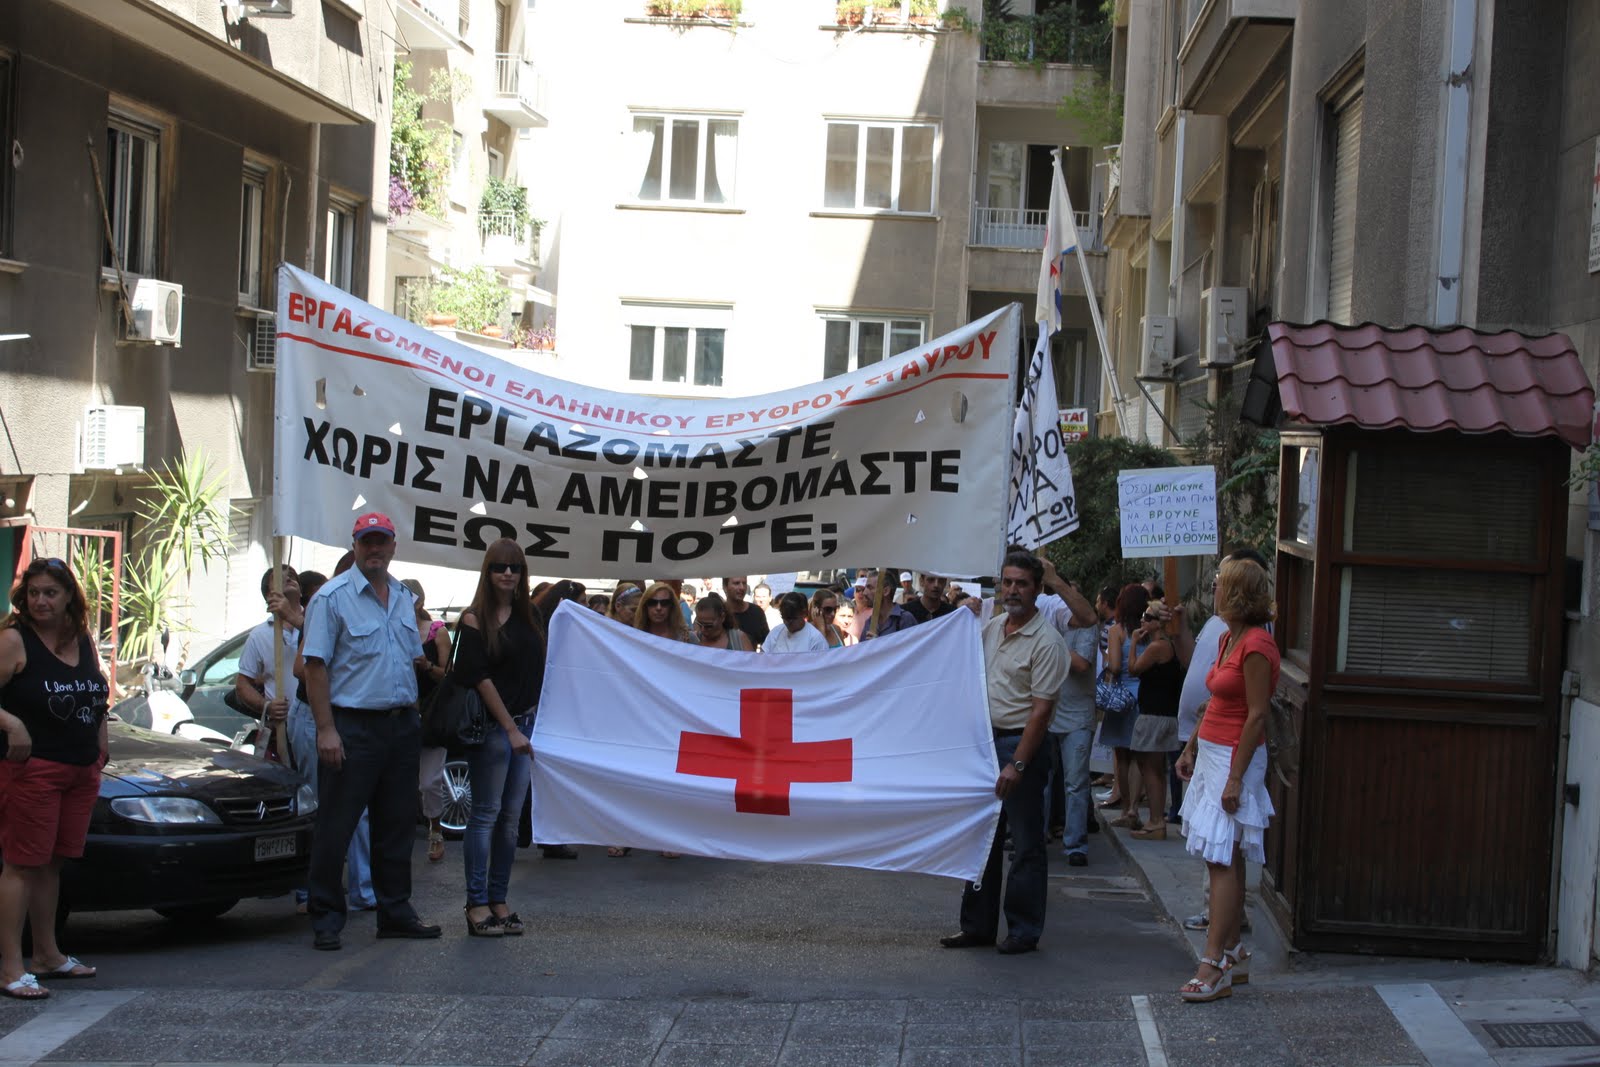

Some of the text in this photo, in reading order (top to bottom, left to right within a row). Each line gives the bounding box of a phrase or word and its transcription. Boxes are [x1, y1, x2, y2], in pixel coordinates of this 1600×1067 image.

[288, 292, 497, 388] ΕΡΓΑΖΟΜΕΝΟΙ
[505, 379, 697, 430] ΕΛΛΗΝΙΚΟΥ
[705, 384, 854, 429] ΕΡΥΘΡΟΥ
[865, 331, 997, 386] ΣΤΑΥΡΟΥ
[424, 387, 835, 469] ΕΡΓΑΖΟΜΑΣΤΕ
[303, 416, 444, 493] ΧΩΡΙΣ
[462, 455, 538, 508] ΝΑ
[556, 450, 961, 518] ΑΜΕΙΒΟΜΑΣΤΕ
[412, 505, 838, 563] ΕΩΣ ΠΟΤΕ;
[1127, 508, 1200, 521] ΝΑ ΒΡΟΥΝΕ
[1130, 519, 1217, 533] ΚΑΙ ΕΜΕΙΣ
[54, 681, 74, 693] love
[87, 679, 101, 692] be
